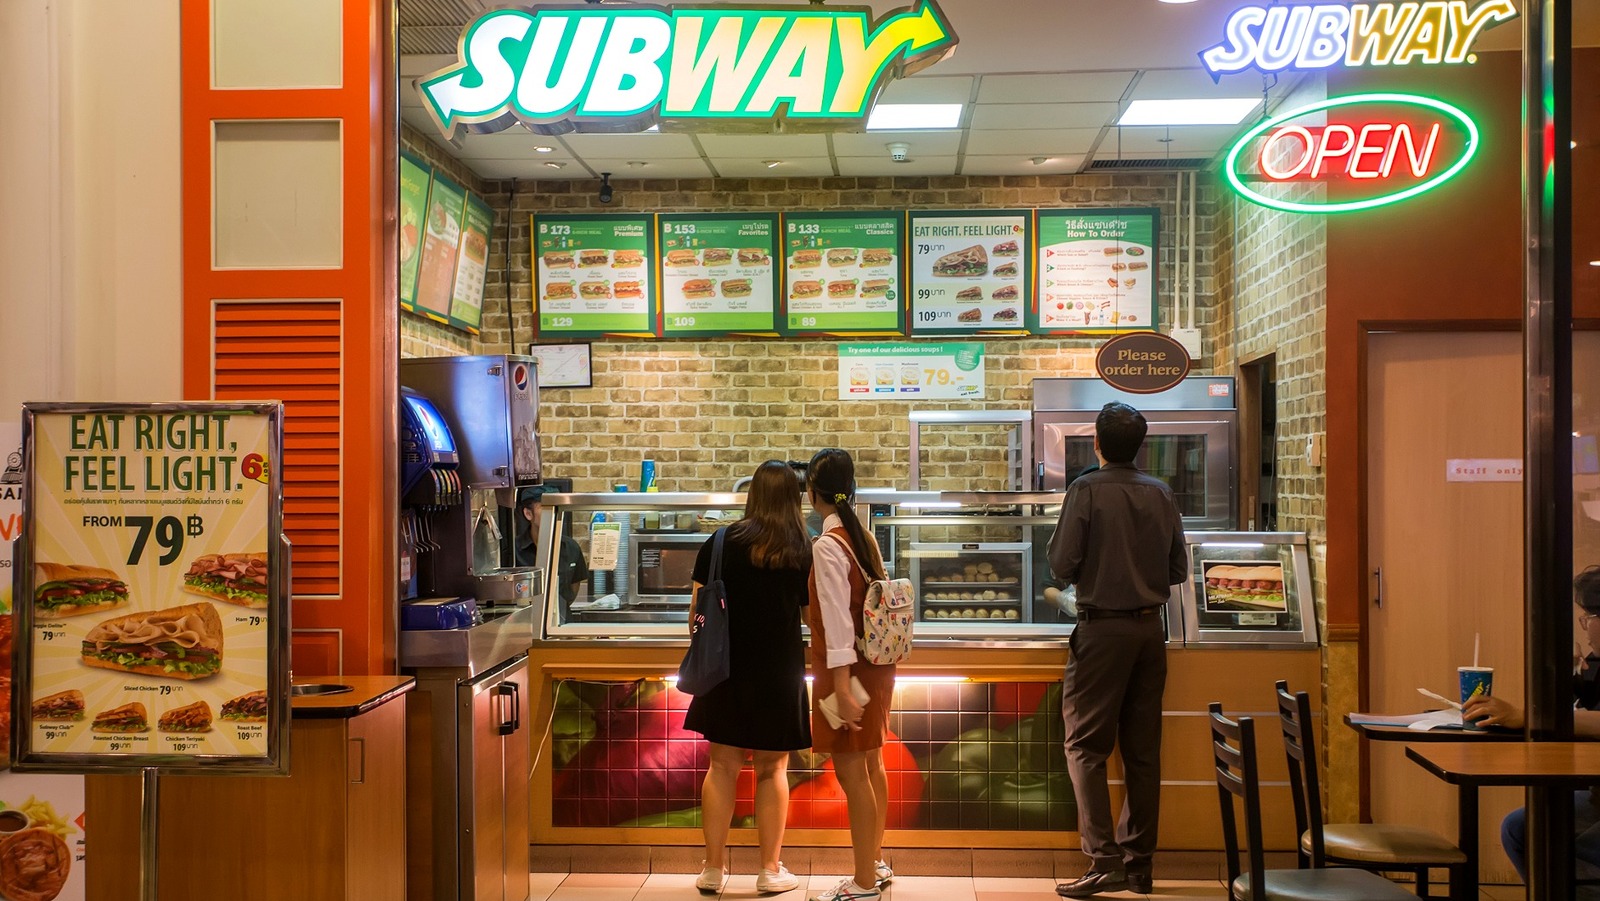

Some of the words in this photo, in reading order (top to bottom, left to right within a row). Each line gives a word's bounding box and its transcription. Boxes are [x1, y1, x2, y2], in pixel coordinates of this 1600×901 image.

[1203, 1, 1516, 71] SUBWAY
[428, 3, 946, 118] SUBWAY
[1261, 123, 1440, 179] OPEN
[551, 225, 570, 235] 173
[674, 224, 695, 234] 153
[799, 224, 819, 234] 133
[914, 226, 930, 237] EAT
[963, 225, 984, 236] FEEL
[986, 225, 1014, 235] LIGHT.
[1067, 230, 1086, 238] How
[918, 244, 929, 254] 79
[918, 289, 930, 299] 99
[918, 311, 936, 321] 109
[552, 317, 573, 327] 129
[674, 317, 695, 326] 109
[802, 317, 816, 326] 89
[921, 346, 939, 354] soups
[1117, 349, 1167, 361] Please
[1104, 364, 1143, 376] order
[1148, 364, 1181, 375] here
[70, 414, 125, 451] EAT
[134, 414, 238, 454] RIGHT,
[241, 453, 263, 479] 6
[64, 456, 135, 492] FEEL
[144, 456, 243, 492] LIGHT.
[1456, 467, 1487, 475] Staff
[1496, 467, 1523, 476] only
[82, 516, 122, 527] FROM
[124, 515, 184, 566] 79
[249, 616, 260, 626] 79
[42, 631, 53, 640] 79
[160, 685, 171, 695] 79
[46, 731, 55, 739] 99
[238, 732, 250, 740] 109
[110, 742, 119, 750] 99
[173, 743, 186, 751] 109
